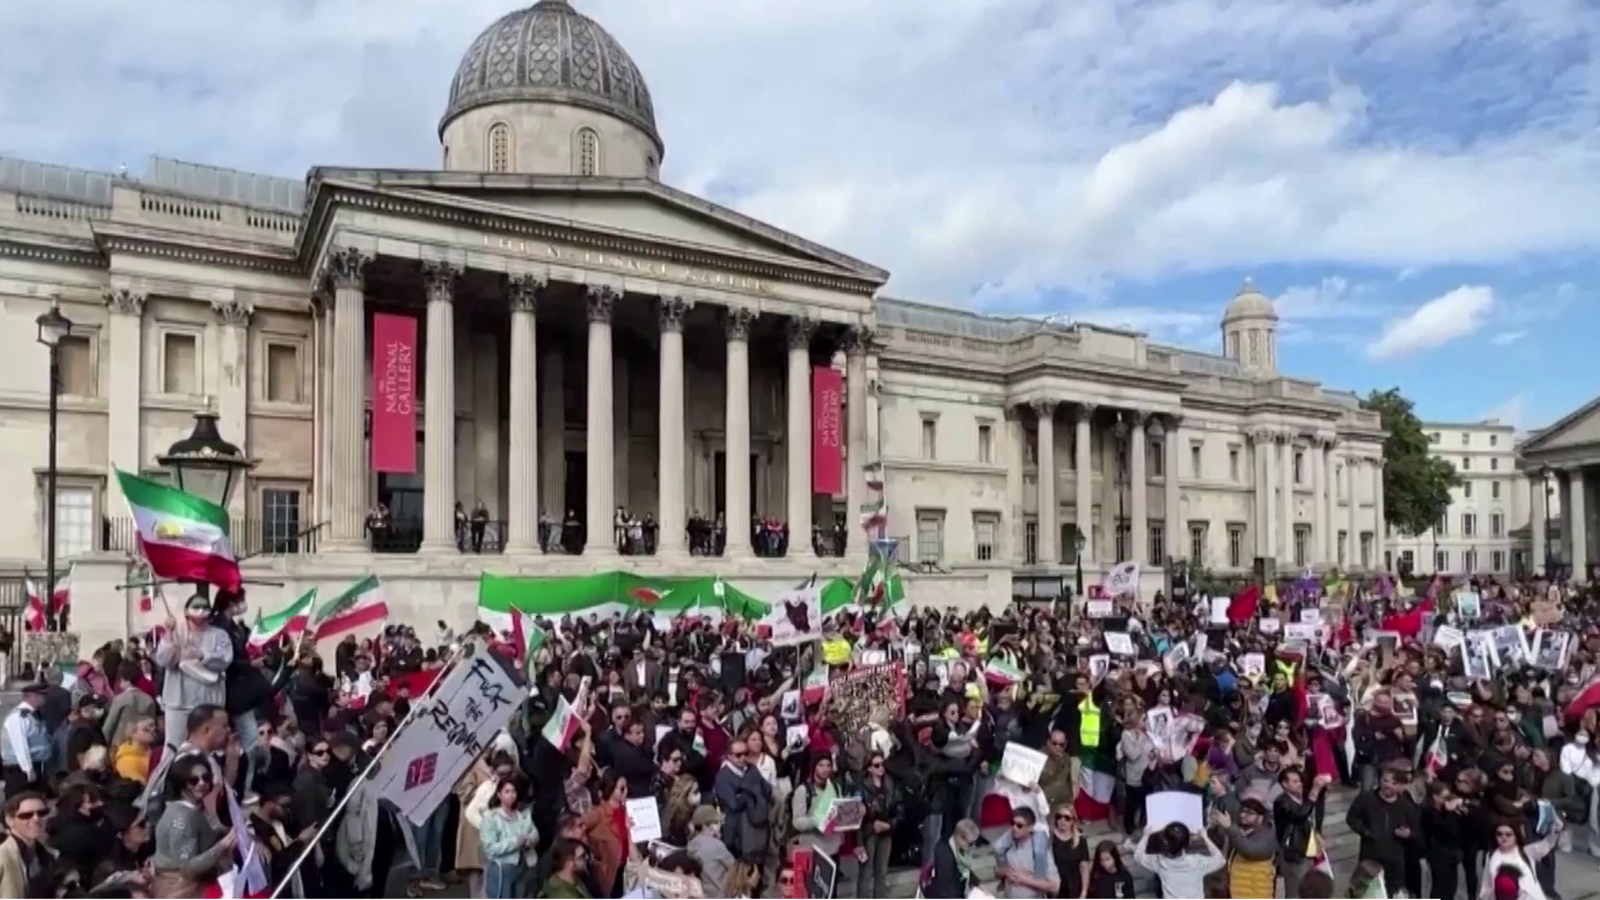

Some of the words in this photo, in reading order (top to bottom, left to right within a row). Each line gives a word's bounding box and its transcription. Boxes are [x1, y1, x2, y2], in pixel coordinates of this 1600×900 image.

[386, 341, 398, 414] NATIONAL
[398, 342, 411, 415] GALLERY
[463, 657, 512, 712] FUCK
[464, 696, 483, 722] THE
